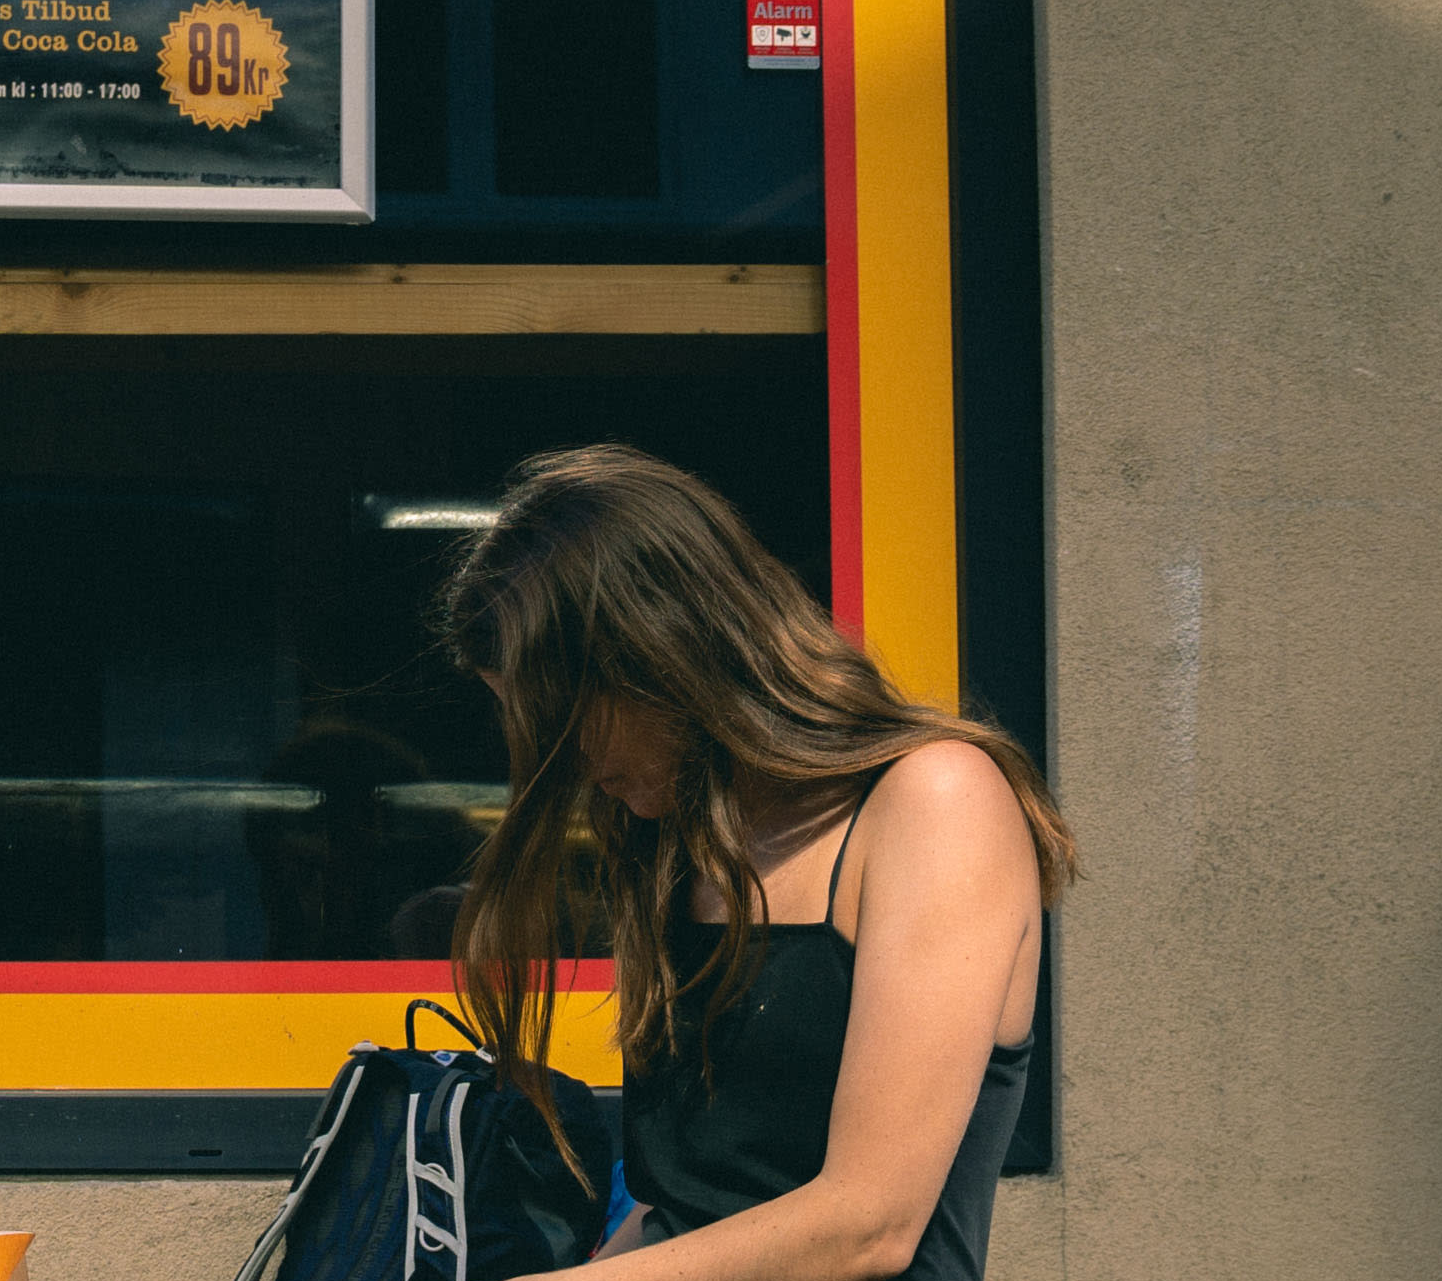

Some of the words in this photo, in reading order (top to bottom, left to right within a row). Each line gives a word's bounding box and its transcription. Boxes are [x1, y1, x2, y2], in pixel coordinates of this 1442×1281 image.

[21, 0, 112, 22] Tilbud
[754, 1, 812, 20] Alarm
[2, 29, 69, 52] Coca
[77, 31, 139, 53] Cola
[41, 82, 83, 98] 11:00
[99, 83, 141, 99] 17:00
